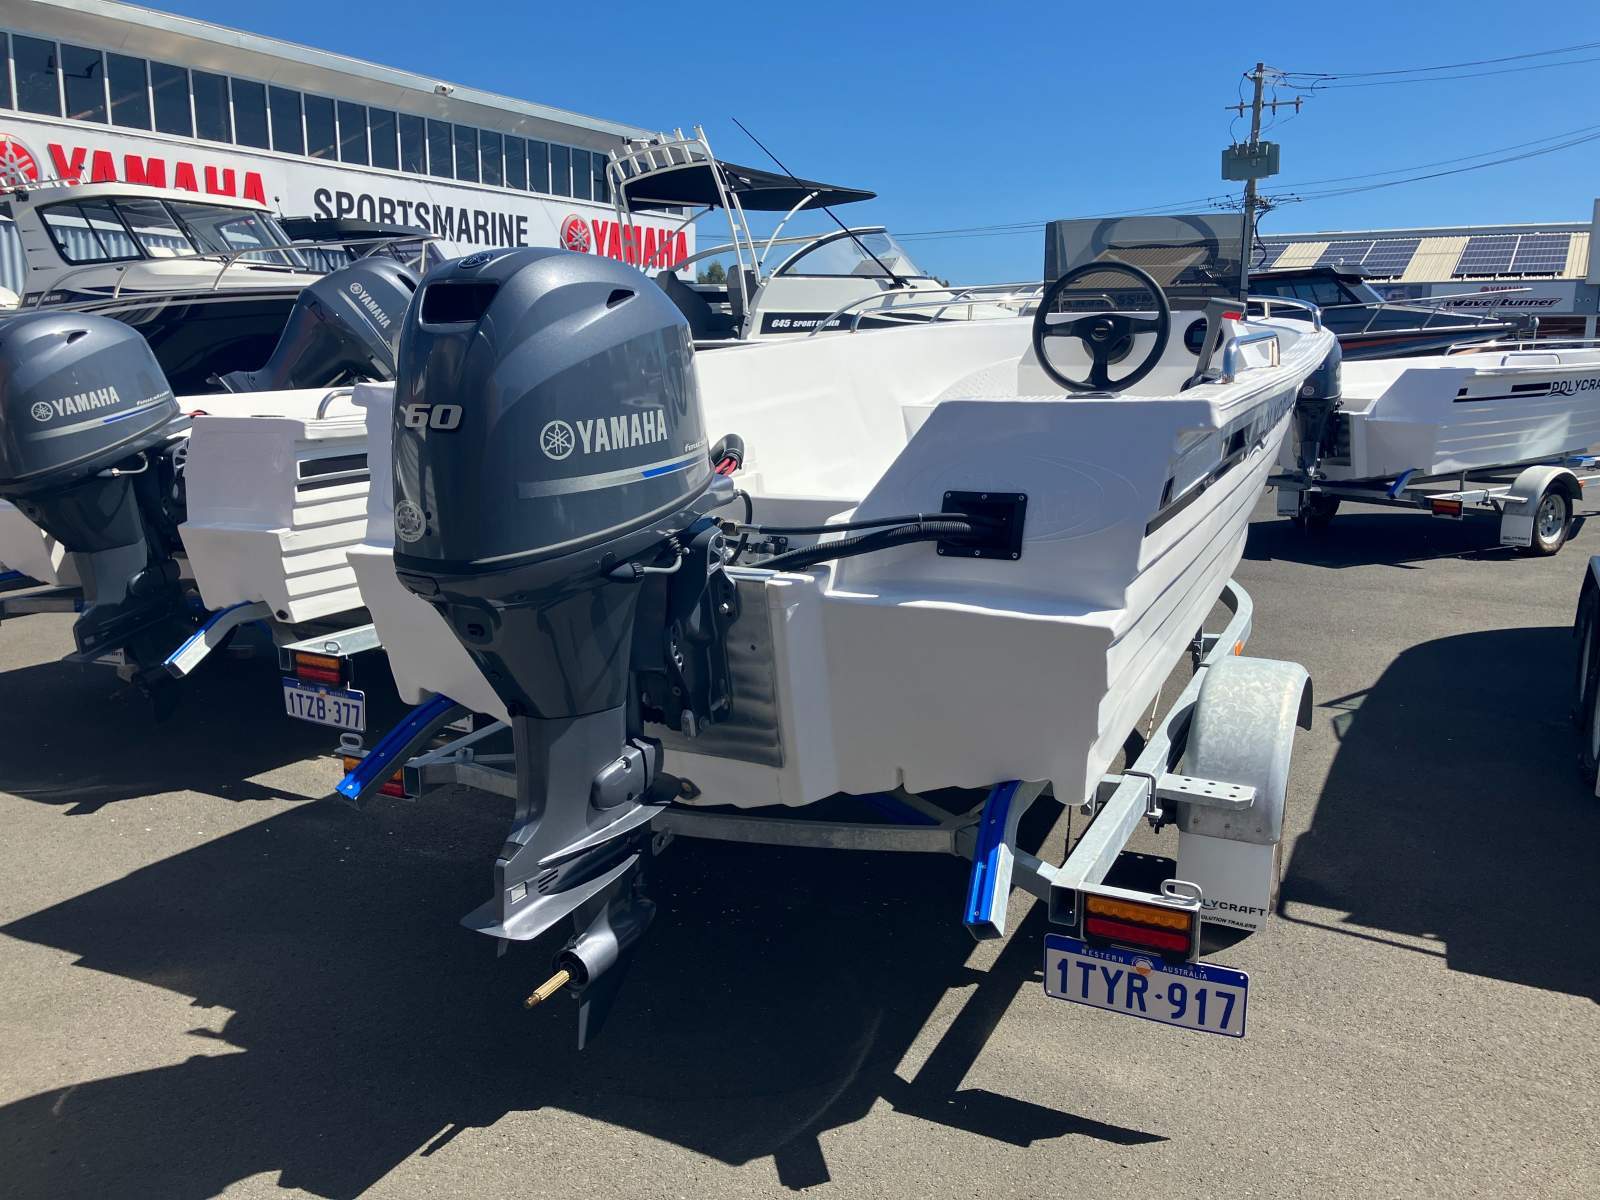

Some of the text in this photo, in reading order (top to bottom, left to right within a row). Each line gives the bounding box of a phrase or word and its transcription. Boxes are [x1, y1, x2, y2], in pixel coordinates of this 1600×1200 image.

[48, 143, 267, 206] YAMAHA
[313, 188, 528, 247] SPORTSMARINE
[591, 219, 690, 272] YAMAHA
[358, 290, 392, 329] YAMAHA
[771, 319, 792, 328] 645
[51, 386, 121, 418] YAMAHA
[576, 409, 668, 454] YAMAHA
[1202, 899, 1266, 916] LYCRAFT
[1081, 949, 1208, 980] WESTERN AUSTRALIA
